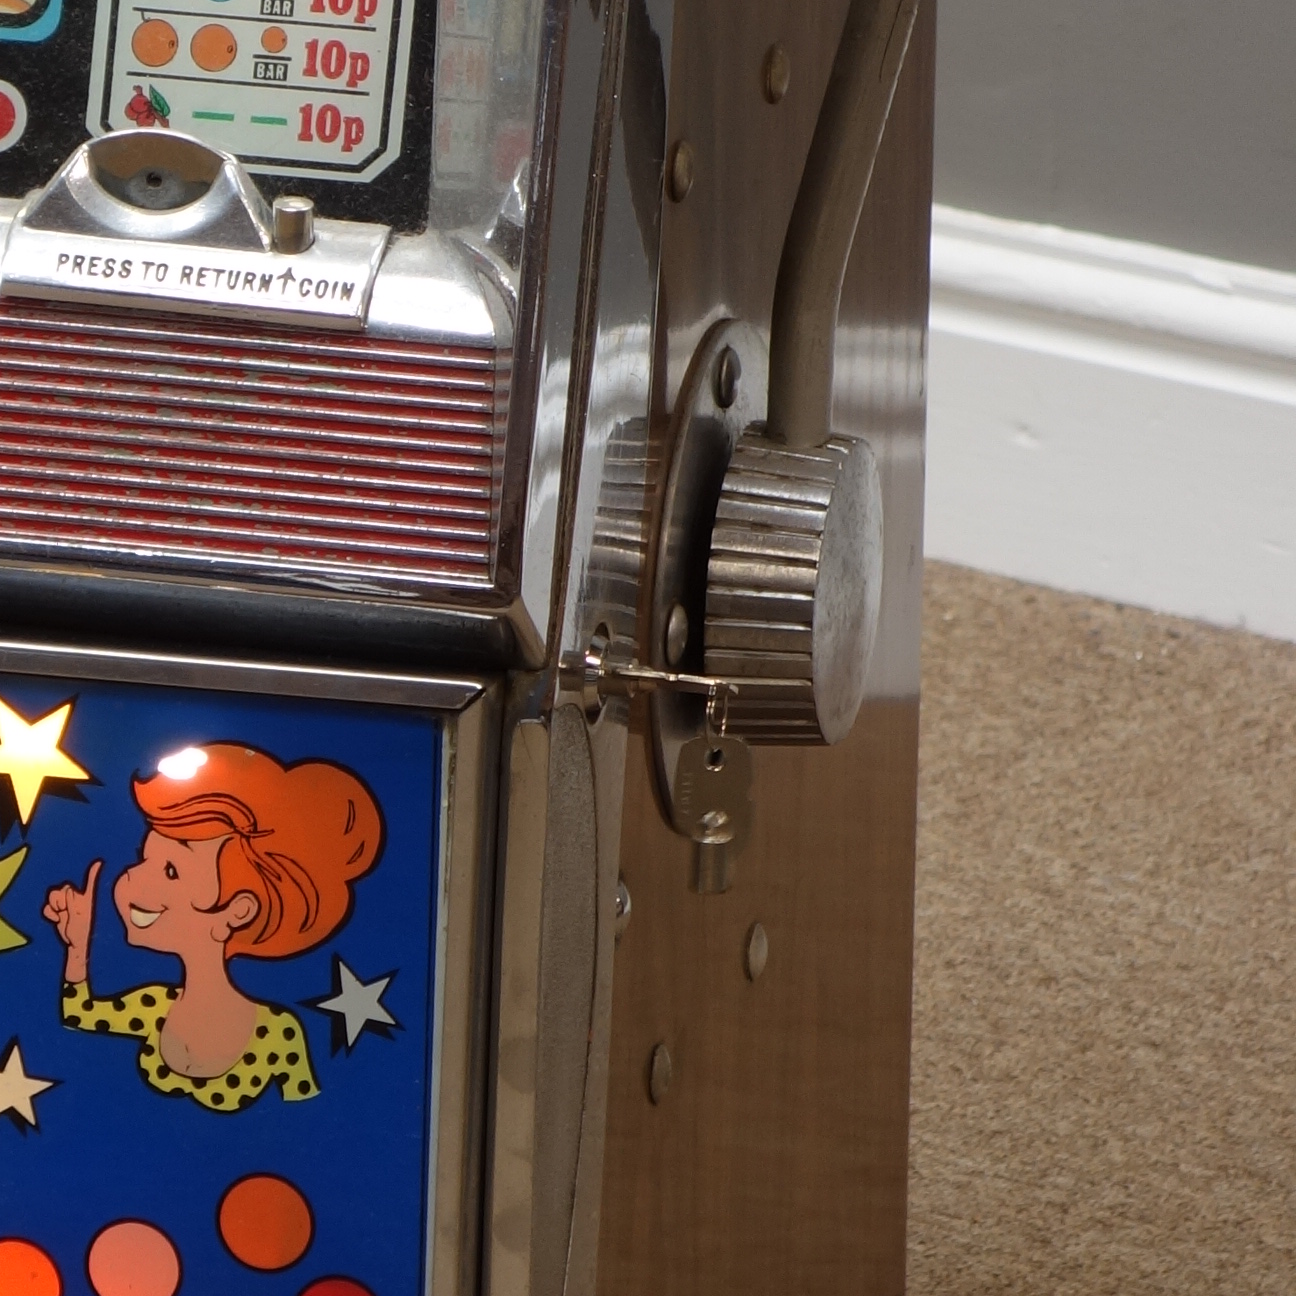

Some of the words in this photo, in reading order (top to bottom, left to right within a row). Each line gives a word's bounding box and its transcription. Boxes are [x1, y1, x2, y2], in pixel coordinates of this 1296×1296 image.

[256, 63, 285, 81] BAR
[302, 38, 371, 88] 10p
[297, 103, 365, 153] 10p
[56, 252, 133, 279] PRESS
[141, 261, 169, 282] TO
[179, 265, 274, 294] RETURN
[298, 277, 356, 302] COIN
